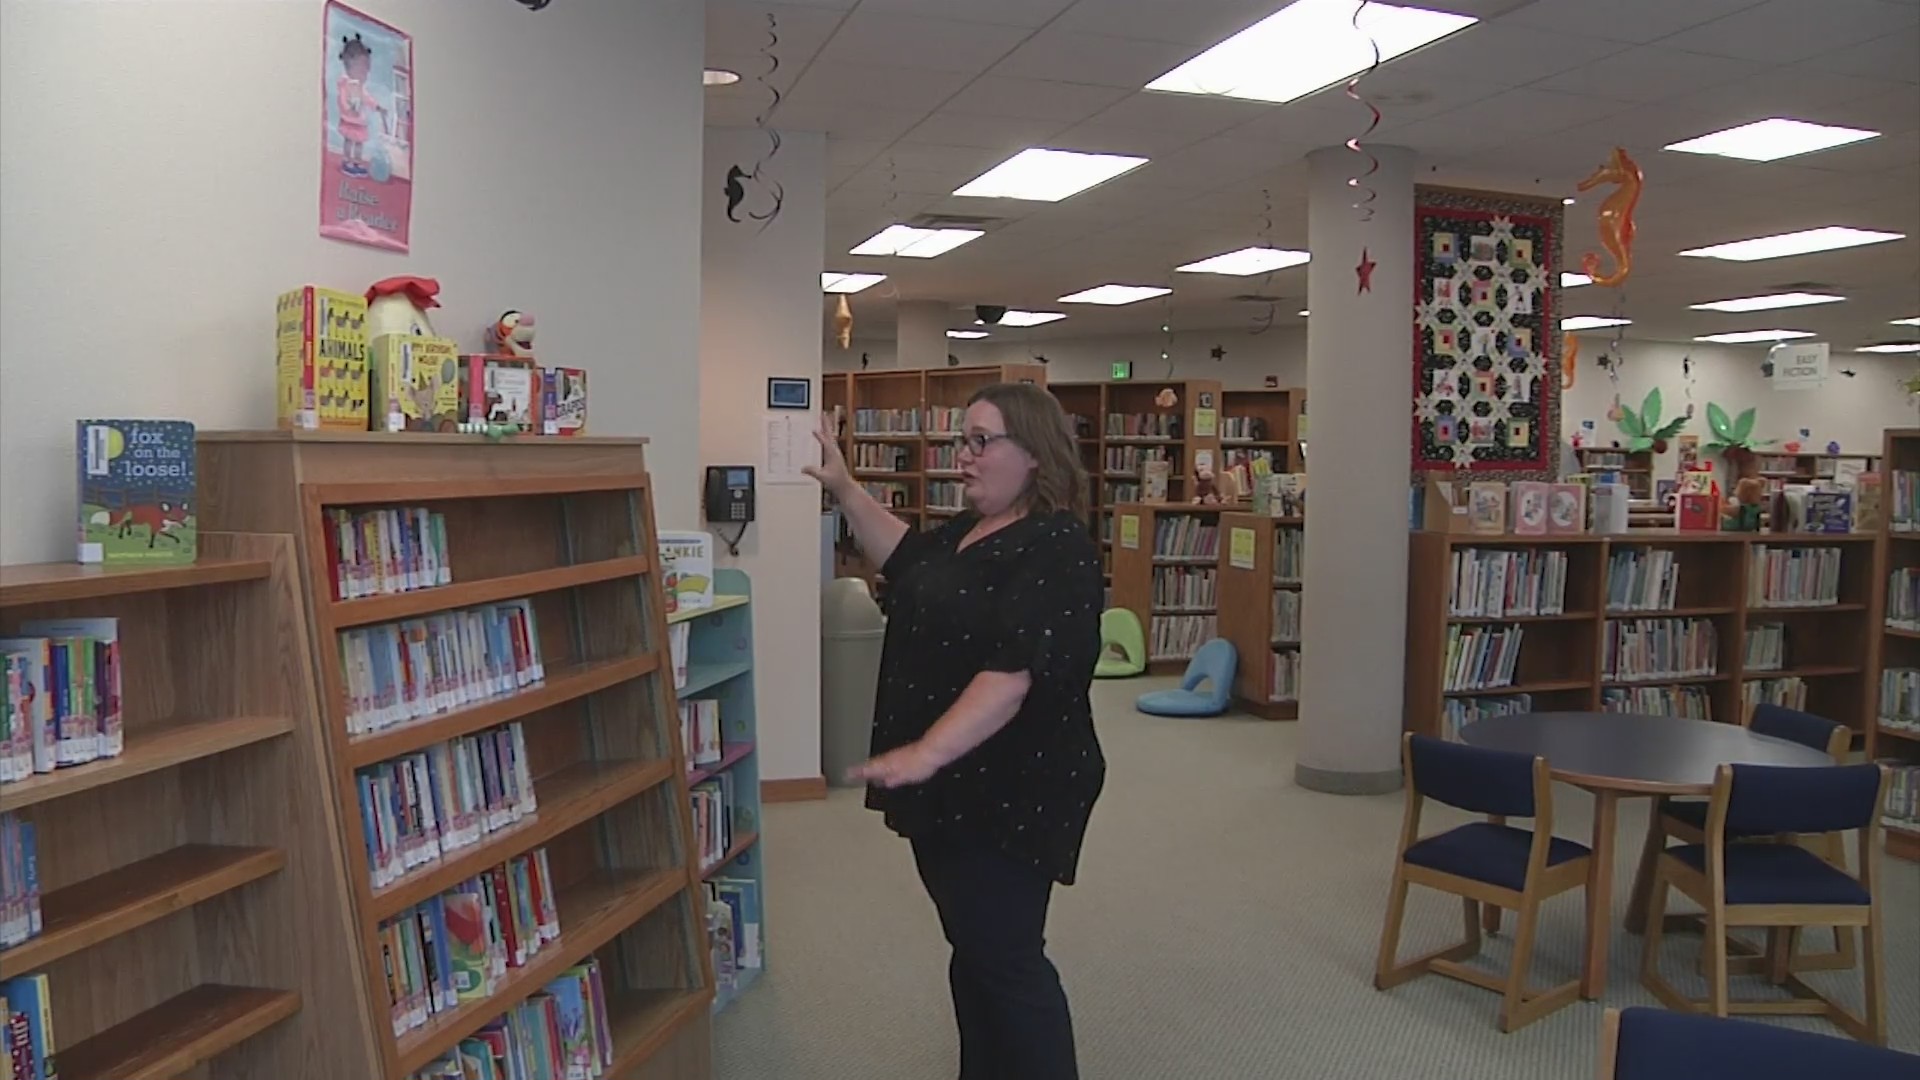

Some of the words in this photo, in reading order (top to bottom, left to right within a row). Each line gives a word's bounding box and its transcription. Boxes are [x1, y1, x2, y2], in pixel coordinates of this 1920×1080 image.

[319, 339, 364, 362] ANIMALS
[1797, 355, 1817, 365] EASY
[1783, 367, 1817, 378] FICTION
[131, 428, 164, 444] fox
[134, 448, 153, 459] on
[157, 447, 181, 459] the
[125, 461, 187, 477] loose!
